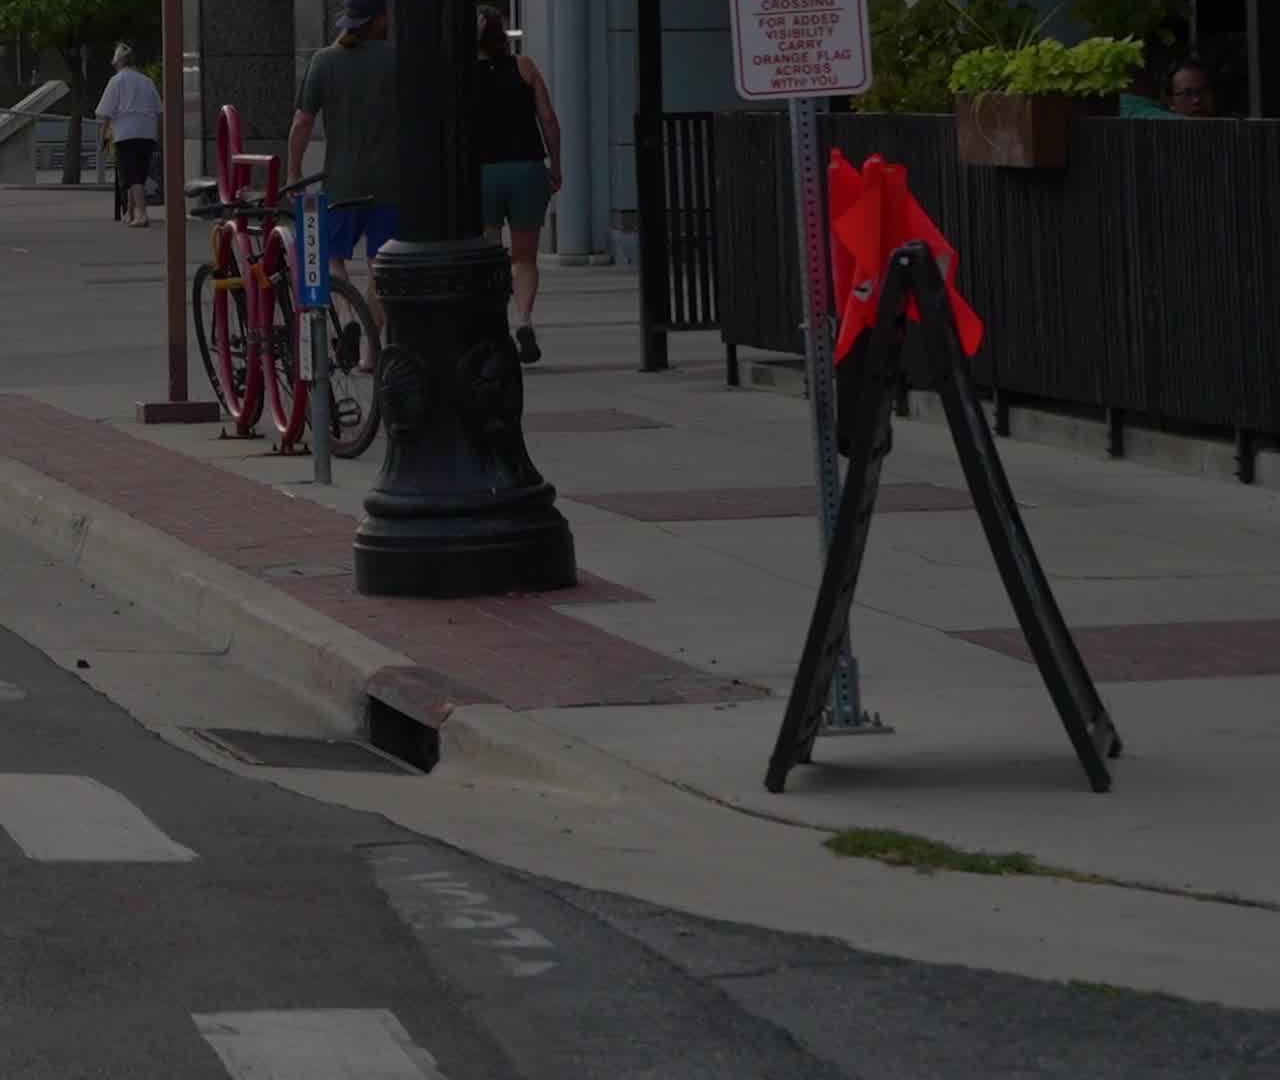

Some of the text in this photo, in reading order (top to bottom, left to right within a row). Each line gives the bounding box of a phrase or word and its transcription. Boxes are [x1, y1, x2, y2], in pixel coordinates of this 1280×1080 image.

[758, 14, 840, 28] FOR ADDED
[765, 27, 833, 40] VISIBILITY
[778, 39, 823, 52] CARRY
[752, 48, 852, 66] ORANGE FLAG
[775, 62, 833, 76] ACROSS
[770, 74, 839, 89] WITH YOU
